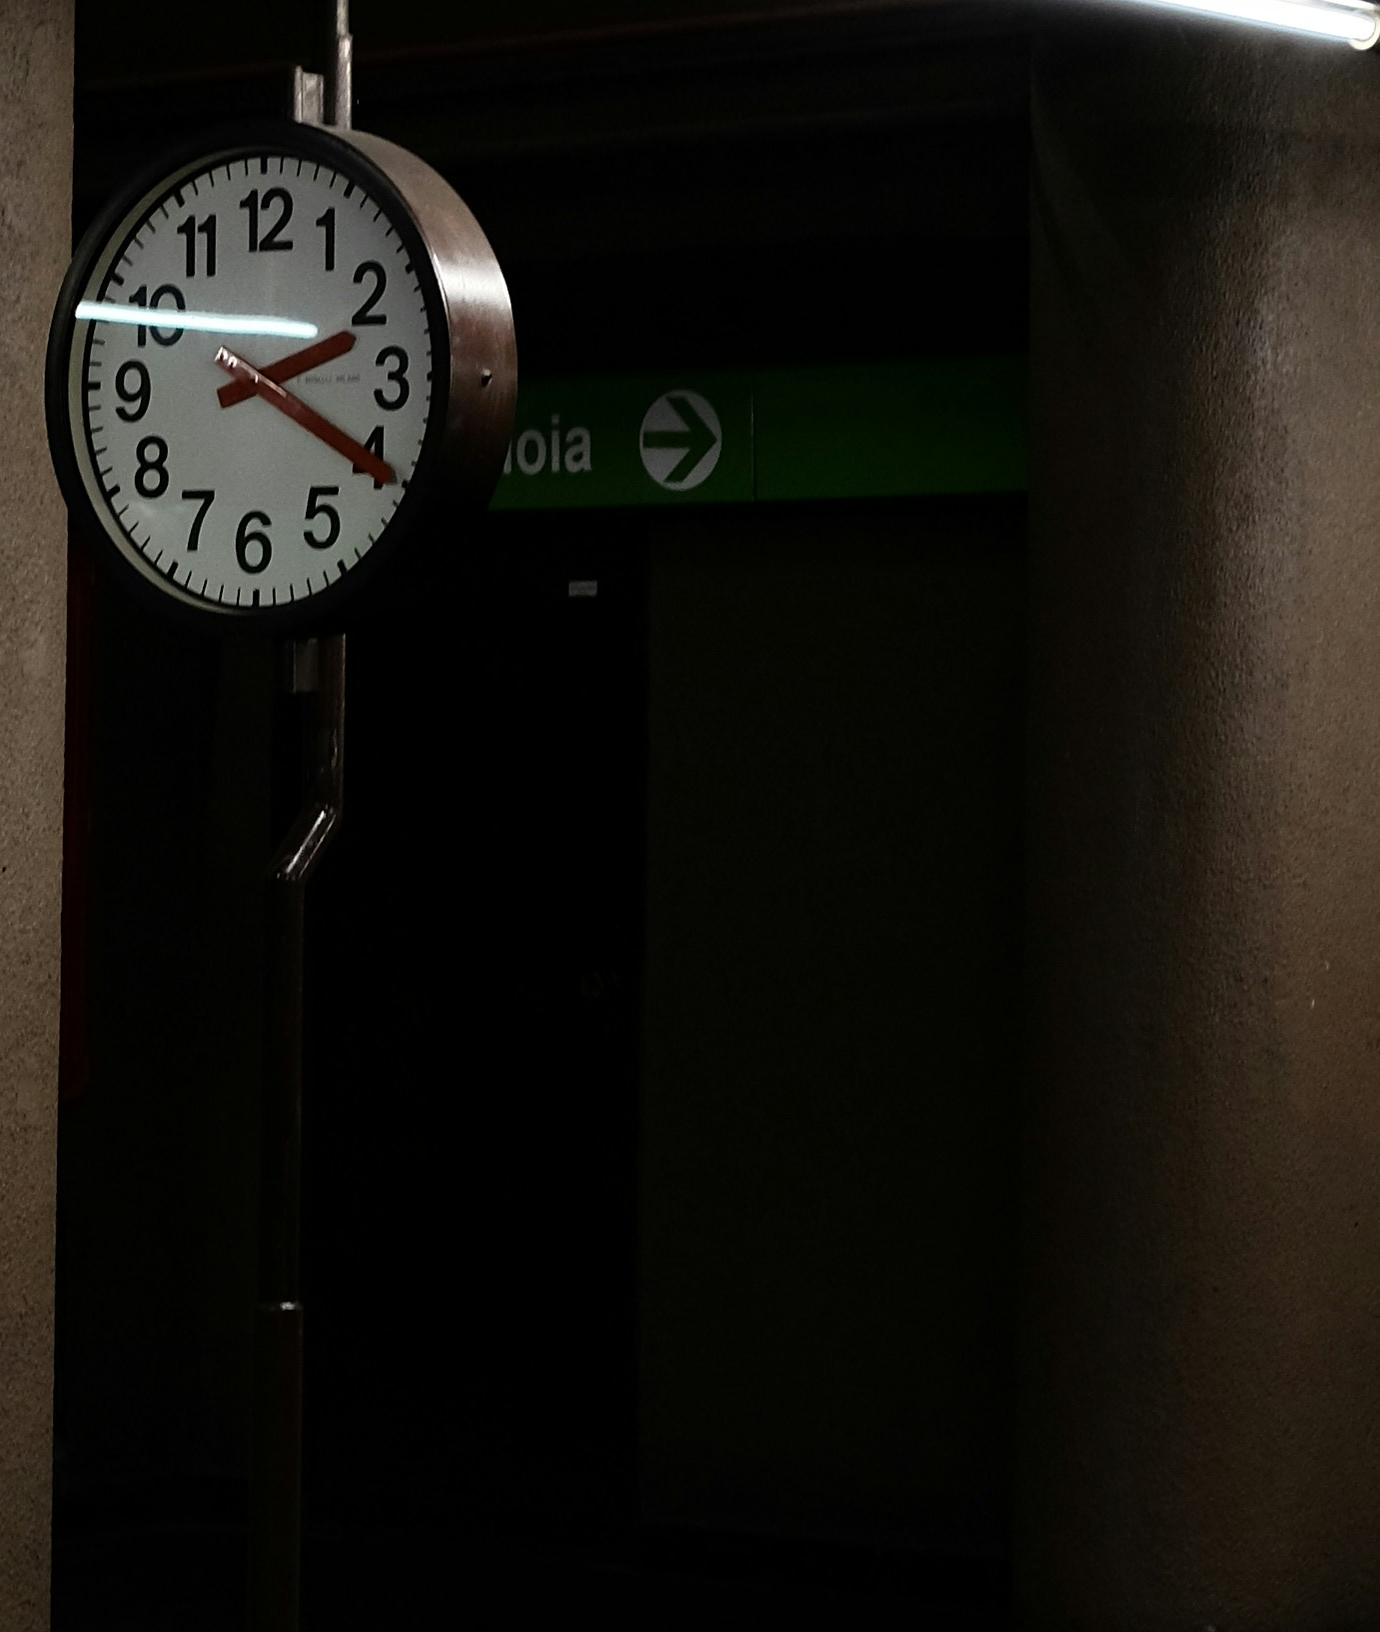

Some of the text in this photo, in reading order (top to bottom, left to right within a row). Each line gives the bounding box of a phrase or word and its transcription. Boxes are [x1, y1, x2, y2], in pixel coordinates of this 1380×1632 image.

[177, 214, 217, 277] 11
[240, 187, 294, 252] 12
[316, 207, 336, 271] 1
[129, 284, 186, 347] 10
[352, 260, 387, 326] 2
[115, 360, 151, 423] 9
[374, 345, 410, 411] 3
[134, 435, 169, 499] 8
[353, 425, 384, 490] 4
[503, 412, 593, 475] oia
[182, 490, 215, 552] 7
[235, 510, 272, 575] 6
[304, 486, 340, 550] 5
